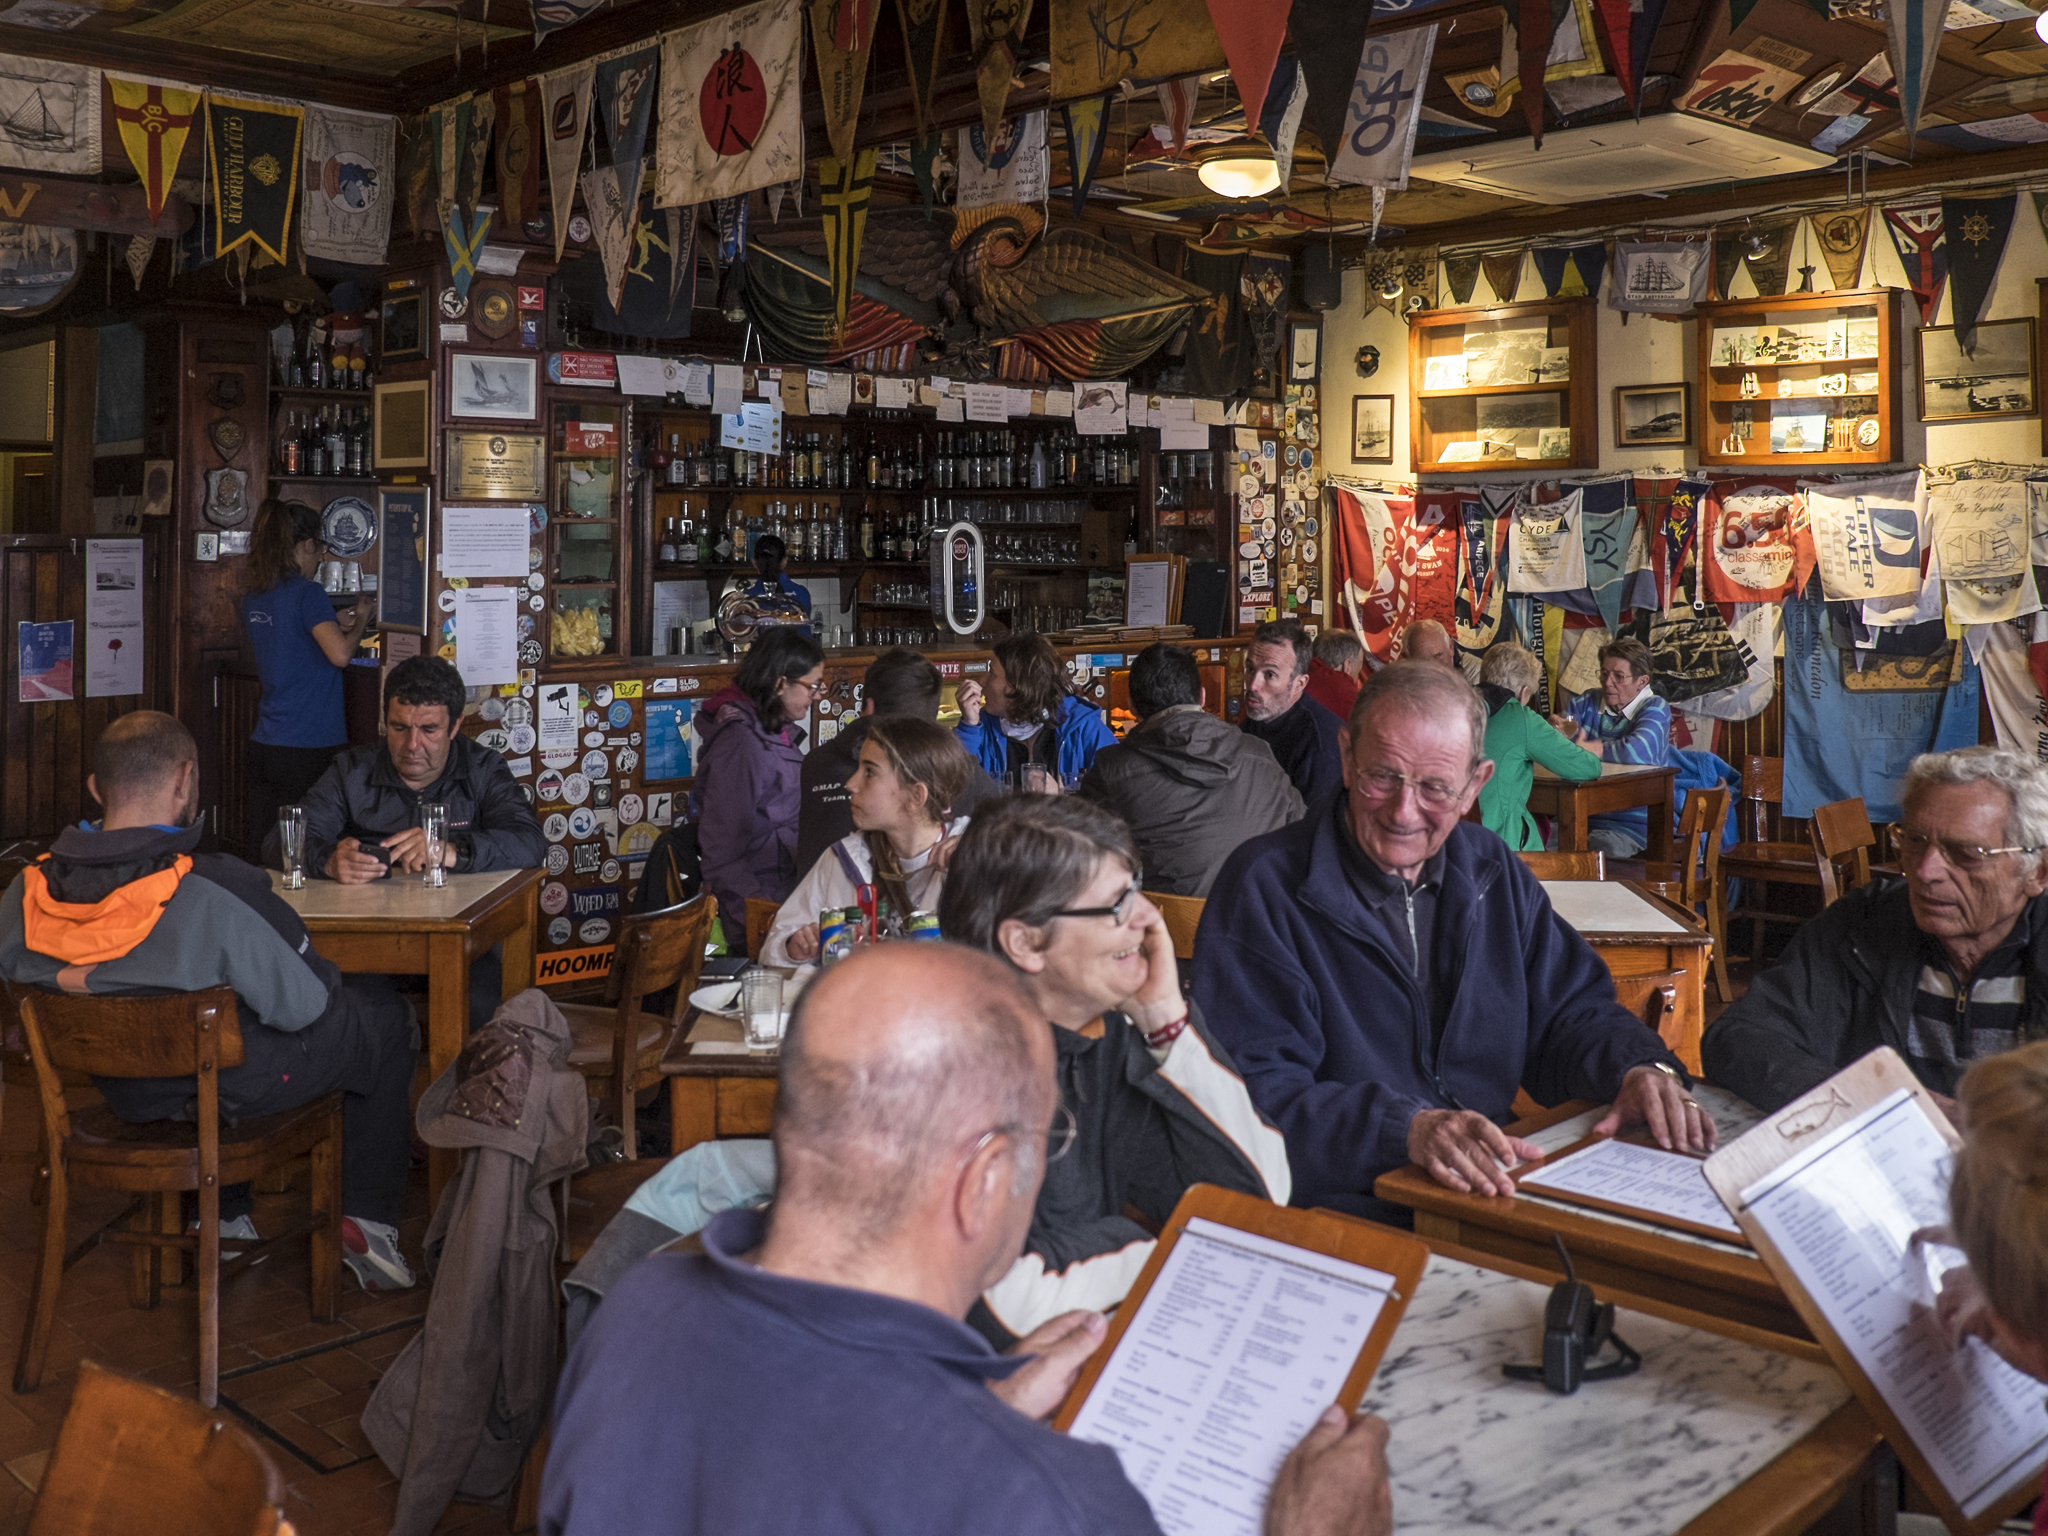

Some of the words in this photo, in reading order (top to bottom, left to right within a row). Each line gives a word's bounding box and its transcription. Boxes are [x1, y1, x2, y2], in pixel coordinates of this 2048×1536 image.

[833, 70, 842, 118] MARINA
[229, 116, 244, 152] GULF
[228, 153, 244, 224] HARBOUR
[1519, 525, 1551, 535] CYDE
[1818, 517, 1833, 575] CLUB
[1830, 510, 1848, 581] YACHT
[1845, 515, 1861, 573] RACE
[1855, 496, 1875, 589] CLIPPER
[1421, 560, 1443, 570] SWAN
[1475, 539, 1485, 578] ARPEGE
[1242, 592, 1272, 603] EXPLORE
[938, 663, 960, 674] RTE
[1531, 601, 1550, 714] Plouguneau
[574, 843, 601, 869] OUTRAGE
[572, 892, 603, 915] WJFD
